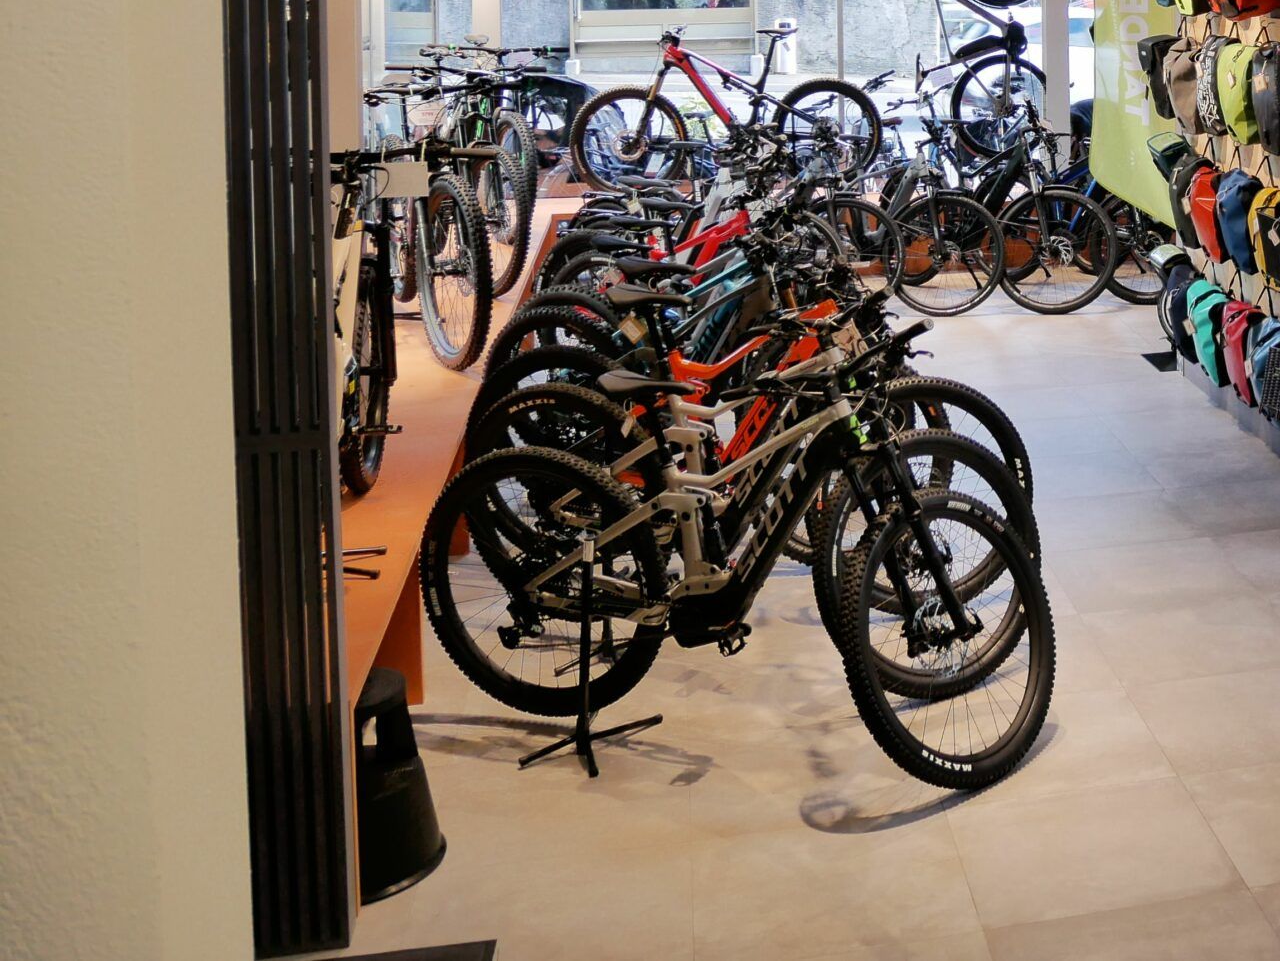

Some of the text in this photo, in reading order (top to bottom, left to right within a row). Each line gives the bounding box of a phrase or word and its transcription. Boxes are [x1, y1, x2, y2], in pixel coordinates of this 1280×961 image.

[508, 398, 556, 414] MAXXIS
[737, 448, 809, 584] SCOTT
[921, 749, 972, 772] MAXXIS
